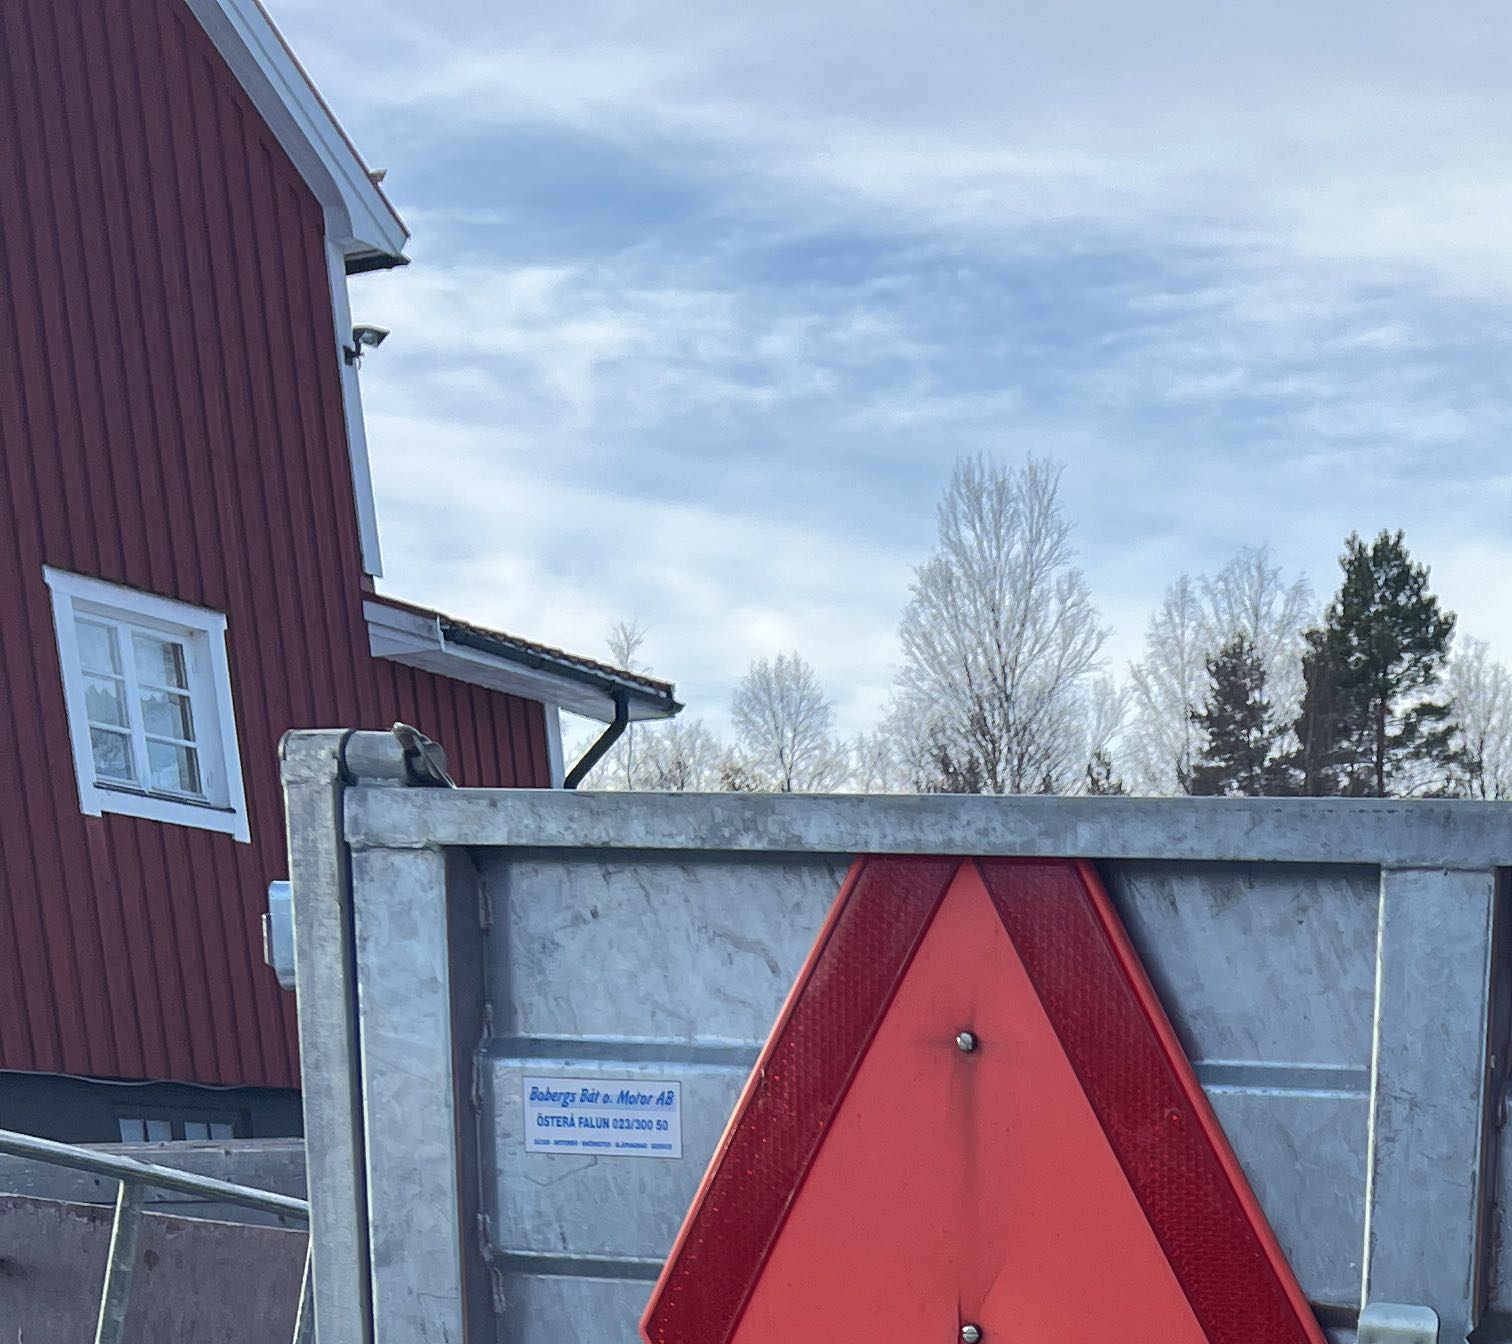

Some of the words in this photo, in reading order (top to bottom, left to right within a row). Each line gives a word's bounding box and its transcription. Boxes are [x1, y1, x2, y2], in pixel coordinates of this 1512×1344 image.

[530, 1086, 577, 1108] Bobergs
[579, 1087, 600, 1104] Båt
[616, 1089, 653, 1105] Motor
[655, 1090, 674, 1107] AB
[537, 1112, 576, 1128] ÖSTERÅ
[578, 1116, 609, 1129] FALUN
[612, 1118, 653, 1131] 023/300
[655, 1119, 669, 1131] 50
